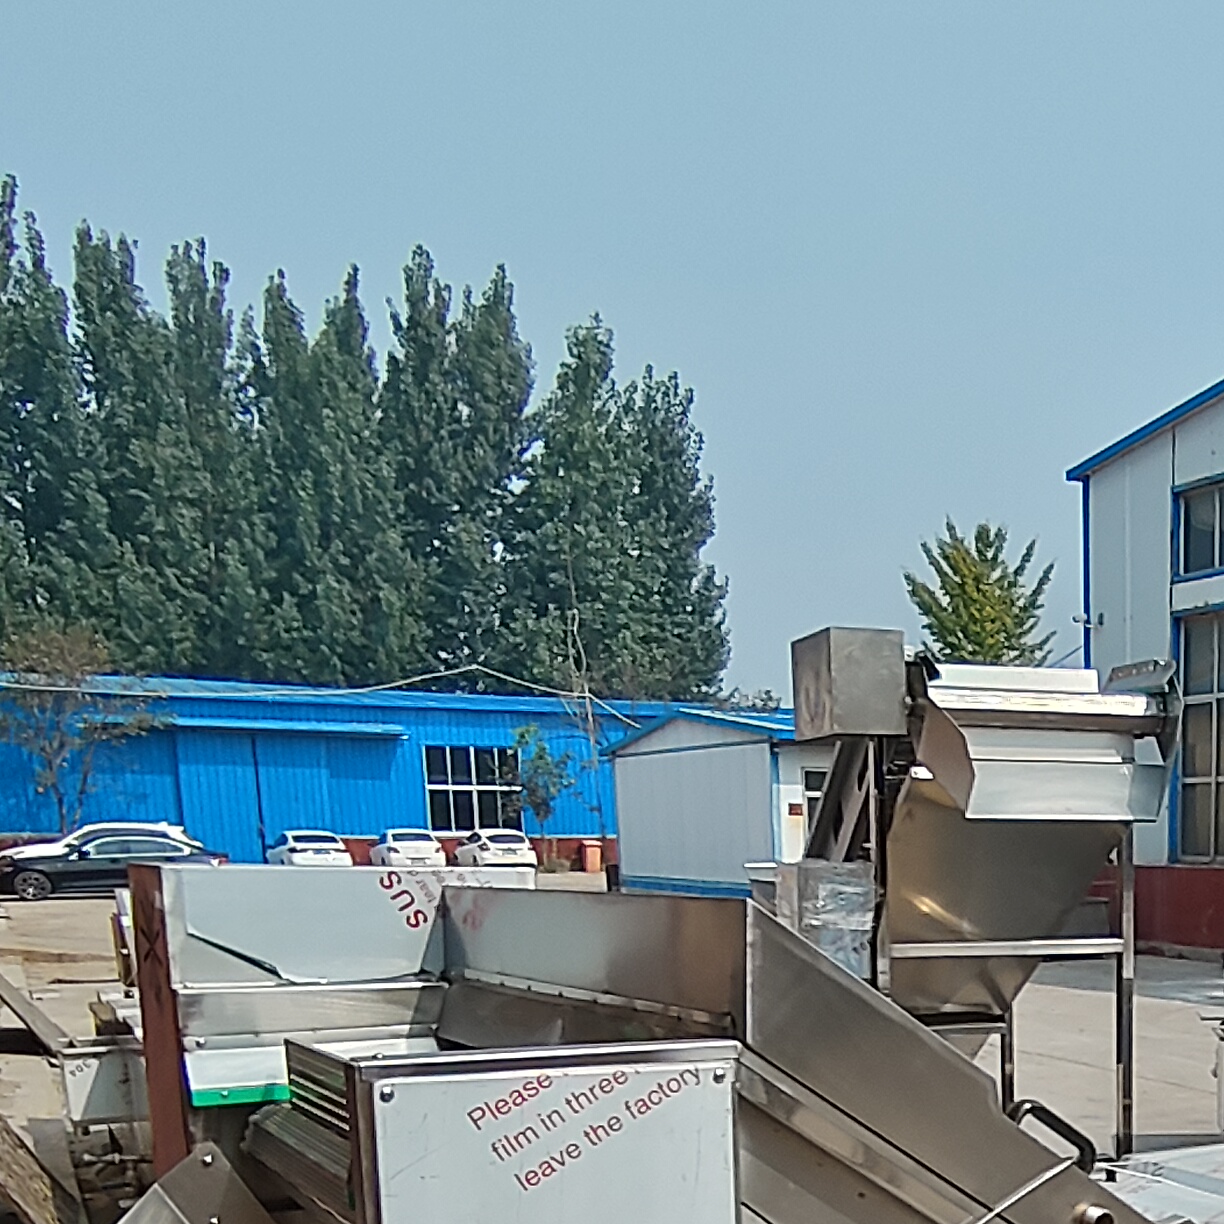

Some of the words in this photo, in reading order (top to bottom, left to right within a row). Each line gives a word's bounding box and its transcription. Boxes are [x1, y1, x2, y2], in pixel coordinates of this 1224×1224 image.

[379, 870, 429, 929] SUS
[466, 1072, 554, 1131] Please
[490, 1124, 541, 1162] film
[537, 1109, 567, 1132] in
[565, 1069, 630, 1115] three
[513, 1142, 583, 1192] leave
[583, 1115, 624, 1147] the
[624, 1067, 701, 1120] factory
